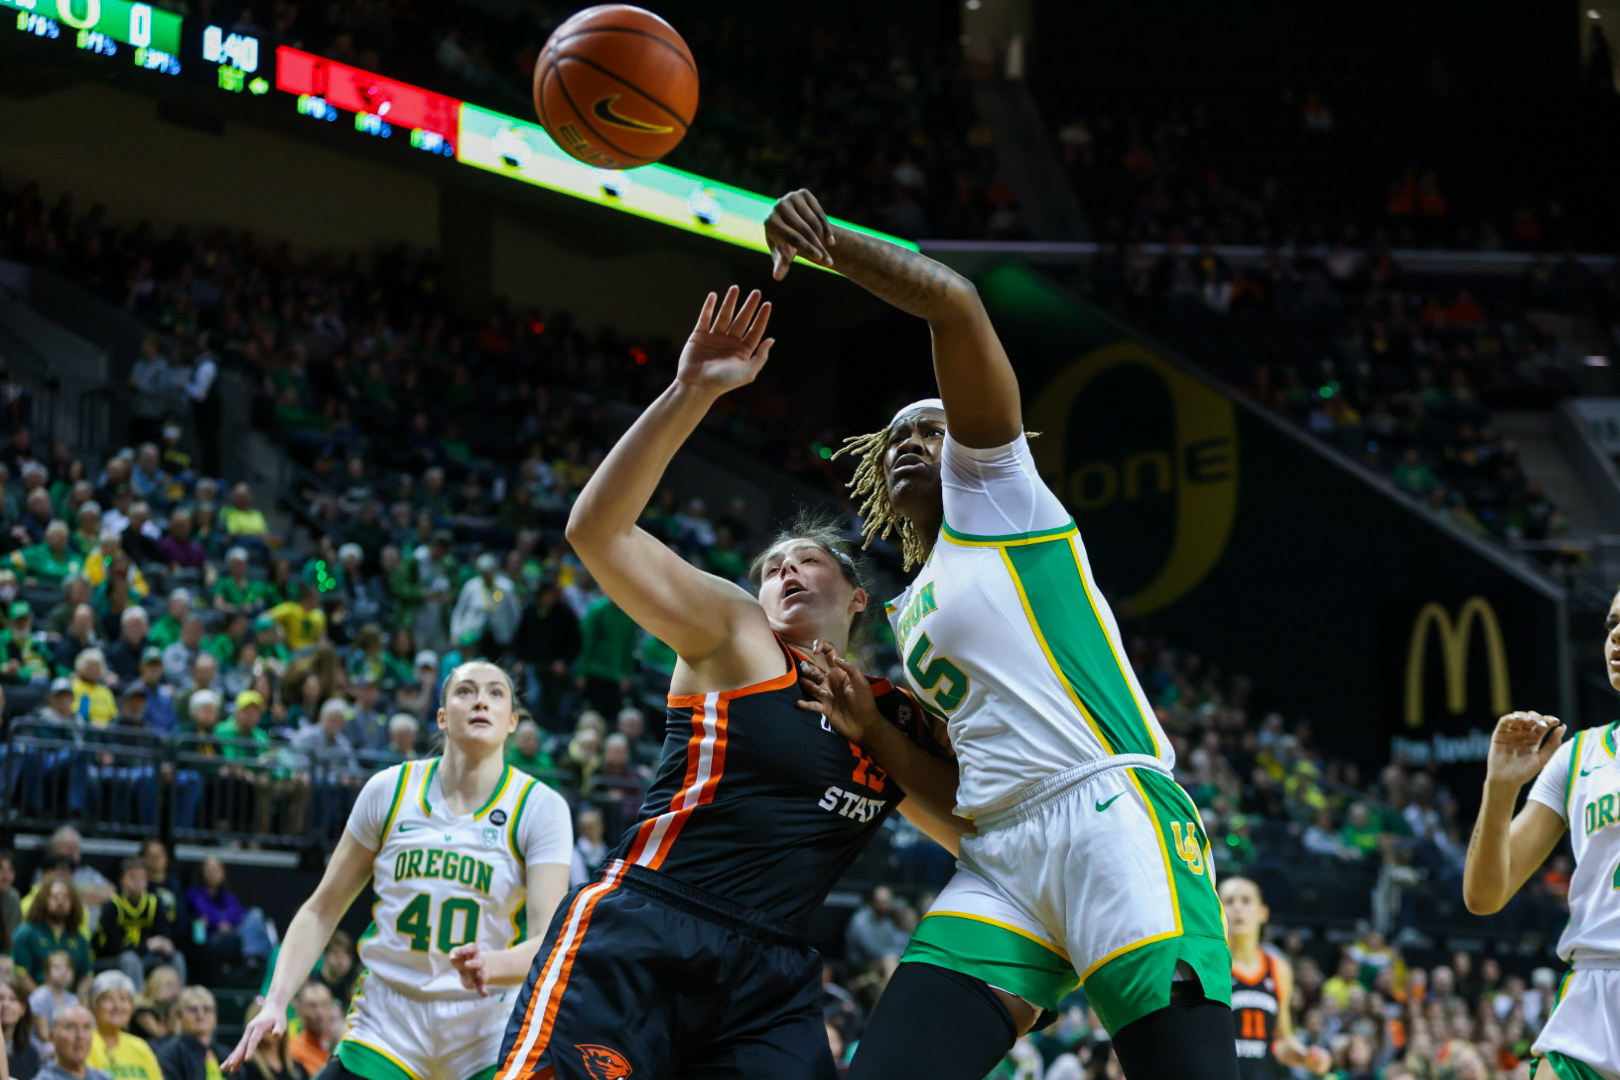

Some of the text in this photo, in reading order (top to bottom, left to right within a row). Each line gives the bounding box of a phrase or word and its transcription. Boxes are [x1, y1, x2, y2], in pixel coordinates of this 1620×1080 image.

[129, 3, 152, 48] 0
[558, 120, 632, 170] ELIT
[818, 786, 886, 822] STAT
[1585, 791, 1620, 836] OR
[394, 848, 494, 896] OREGON
[395, 892, 480, 956] 40
